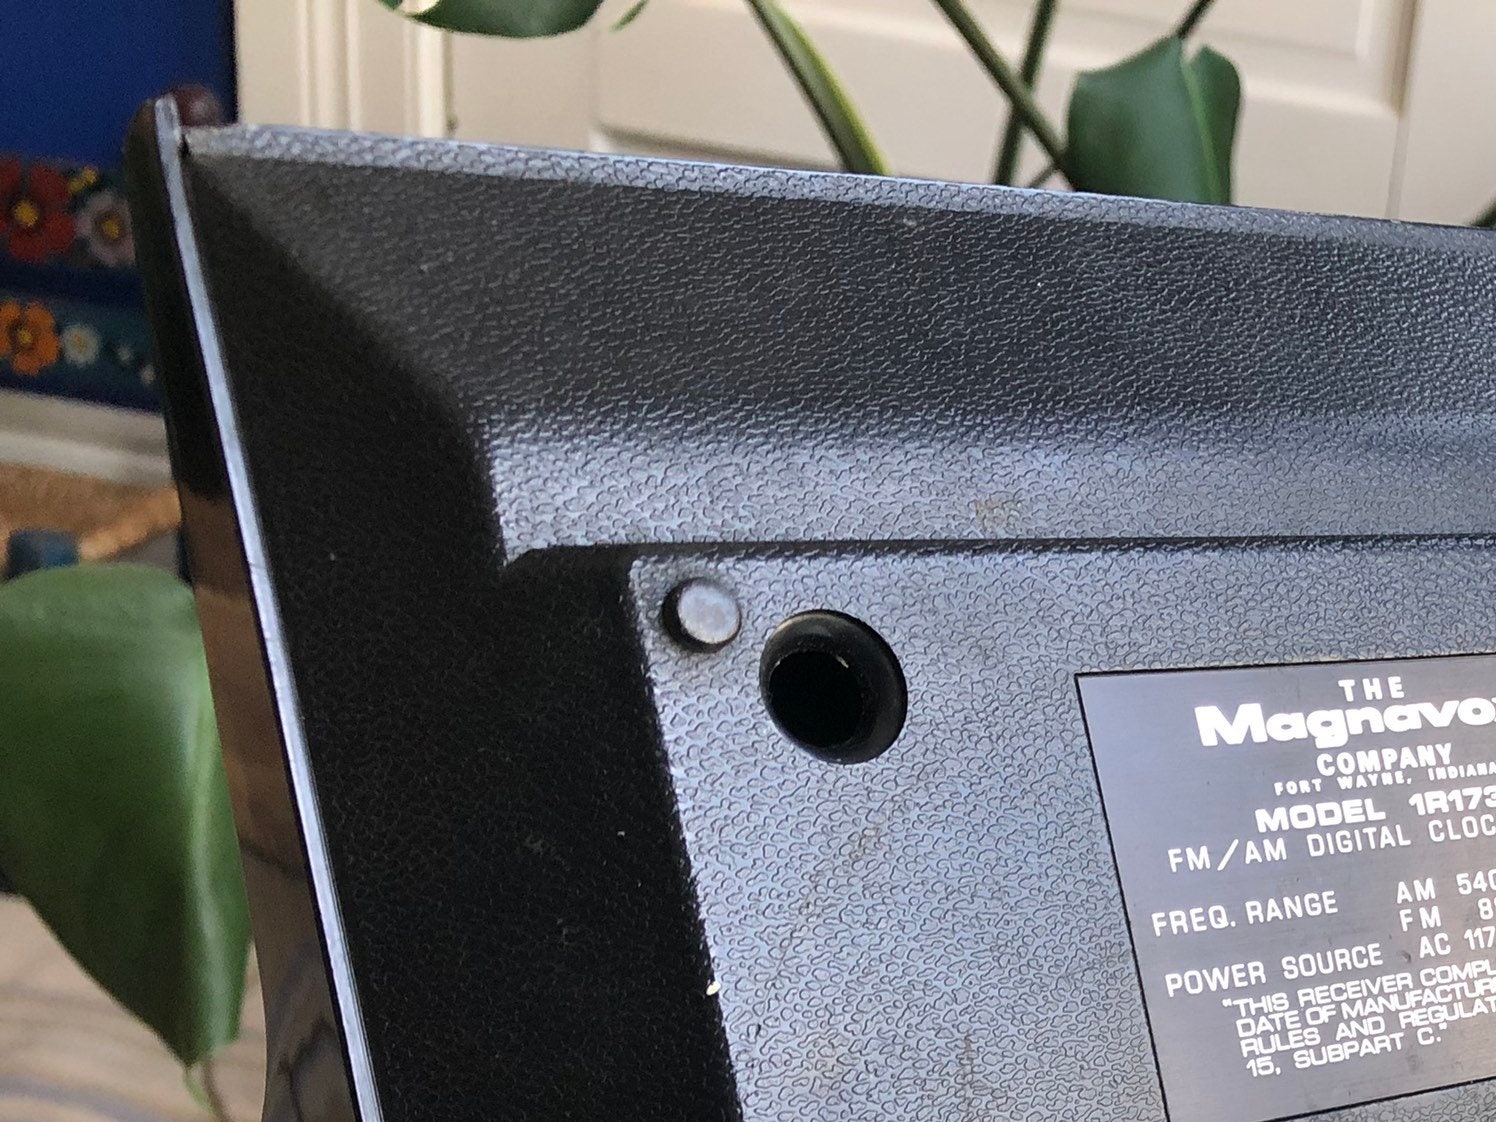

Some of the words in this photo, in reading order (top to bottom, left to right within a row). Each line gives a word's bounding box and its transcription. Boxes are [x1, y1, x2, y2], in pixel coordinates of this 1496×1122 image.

[1338, 676, 1405, 702] THE
[1316, 743, 1451, 776] COMPANY
[1274, 778, 1322, 796] FORT
[1336, 770, 1412, 789] WAYNE,
[1255, 798, 1386, 833] MODEL
[1306, 824, 1411, 857] DIGITAL
[1151, 905, 1236, 936] FREQ.
[1245, 890, 1338, 924] RANGE
[1397, 877, 1436, 904] AM
[1399, 905, 1442, 932] FM
[1165, 961, 1266, 997] POWER
[1281, 942, 1383, 979] SOURCE
[1419, 932, 1451, 958] AC
[1297, 972, 1413, 1007] RECEIVER
[1236, 1010, 1301, 1037] DATE
[1305, 1004, 1336, 1025] OF
[1240, 1027, 1321, 1058] RULES
[1335, 1015, 1385, 1041] AND
[1246, 1055, 1281, 1077] 15,
[1293, 1032, 1404, 1069] SUBPART
